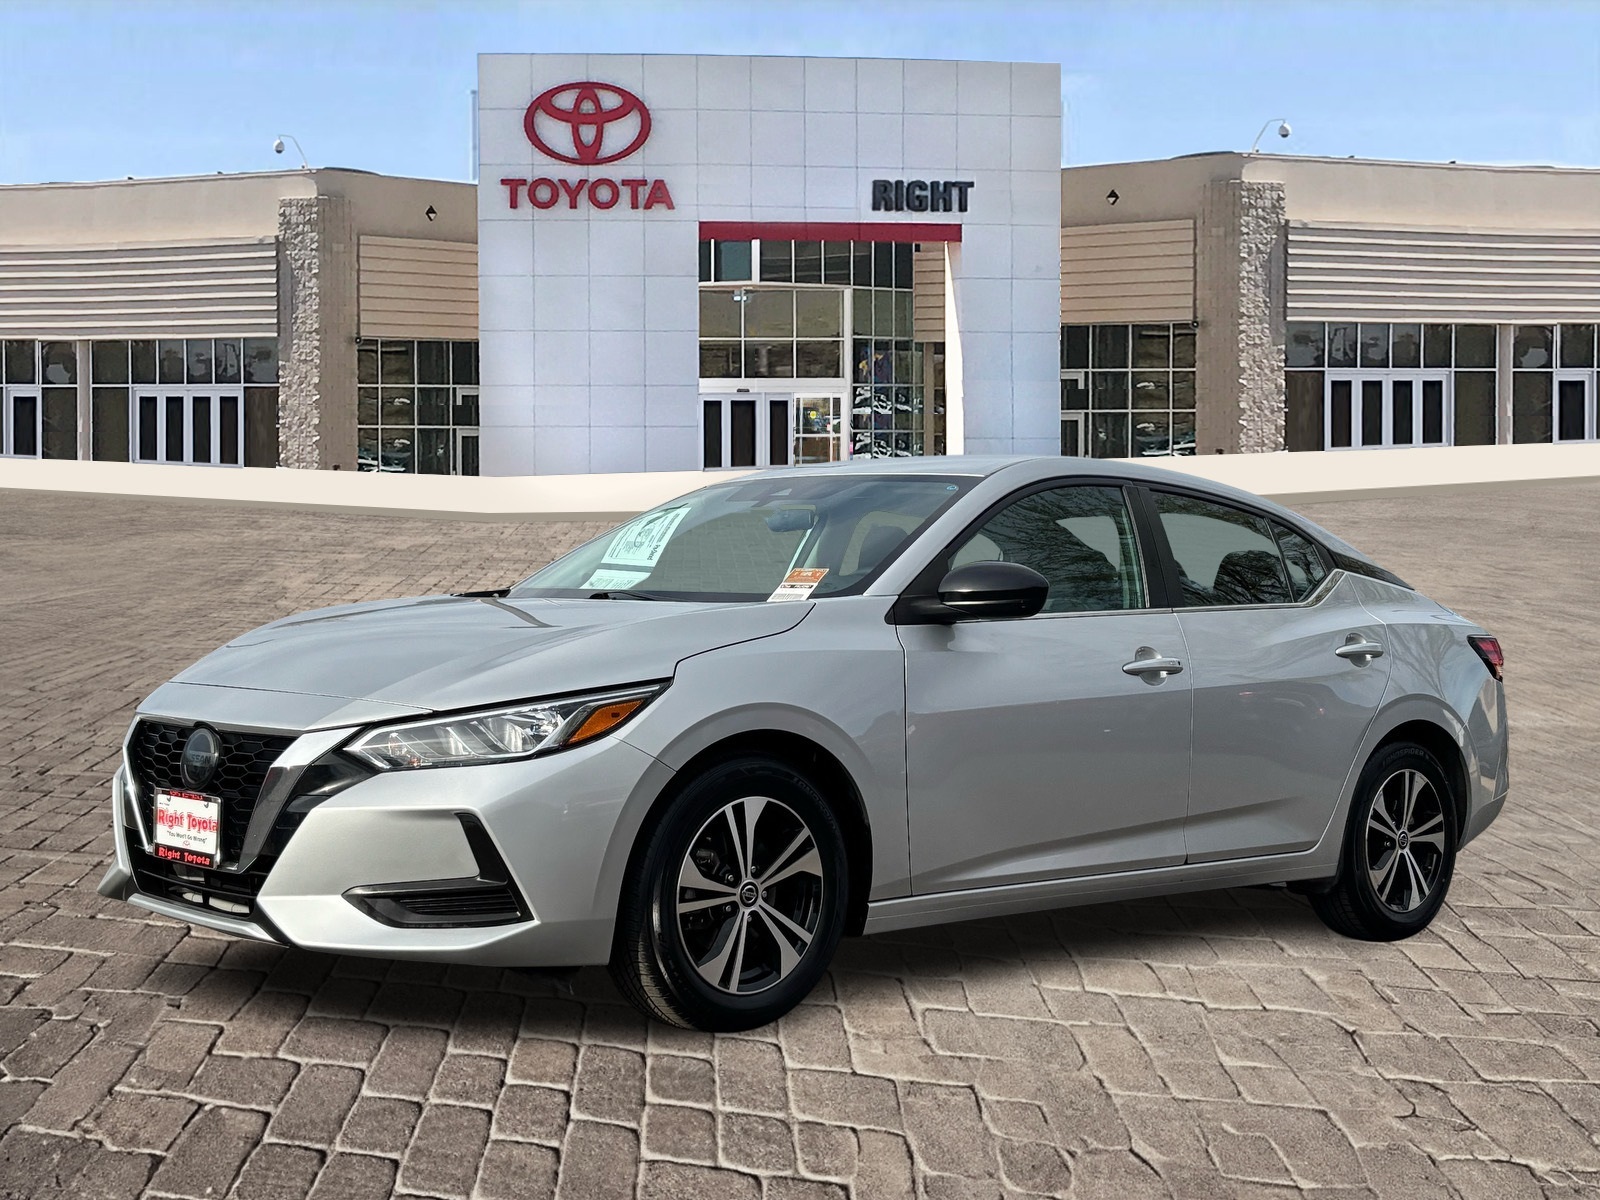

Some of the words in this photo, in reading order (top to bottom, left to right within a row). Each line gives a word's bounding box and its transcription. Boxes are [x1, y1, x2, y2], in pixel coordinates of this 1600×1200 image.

[500, 178, 675, 210] TOYOTA
[871, 179, 975, 212] RIGHT
[156, 807, 185, 830] Right
[187, 812, 218, 833] Toyota
[158, 846, 181, 860] Right
[184, 852, 211, 866] Toyota
